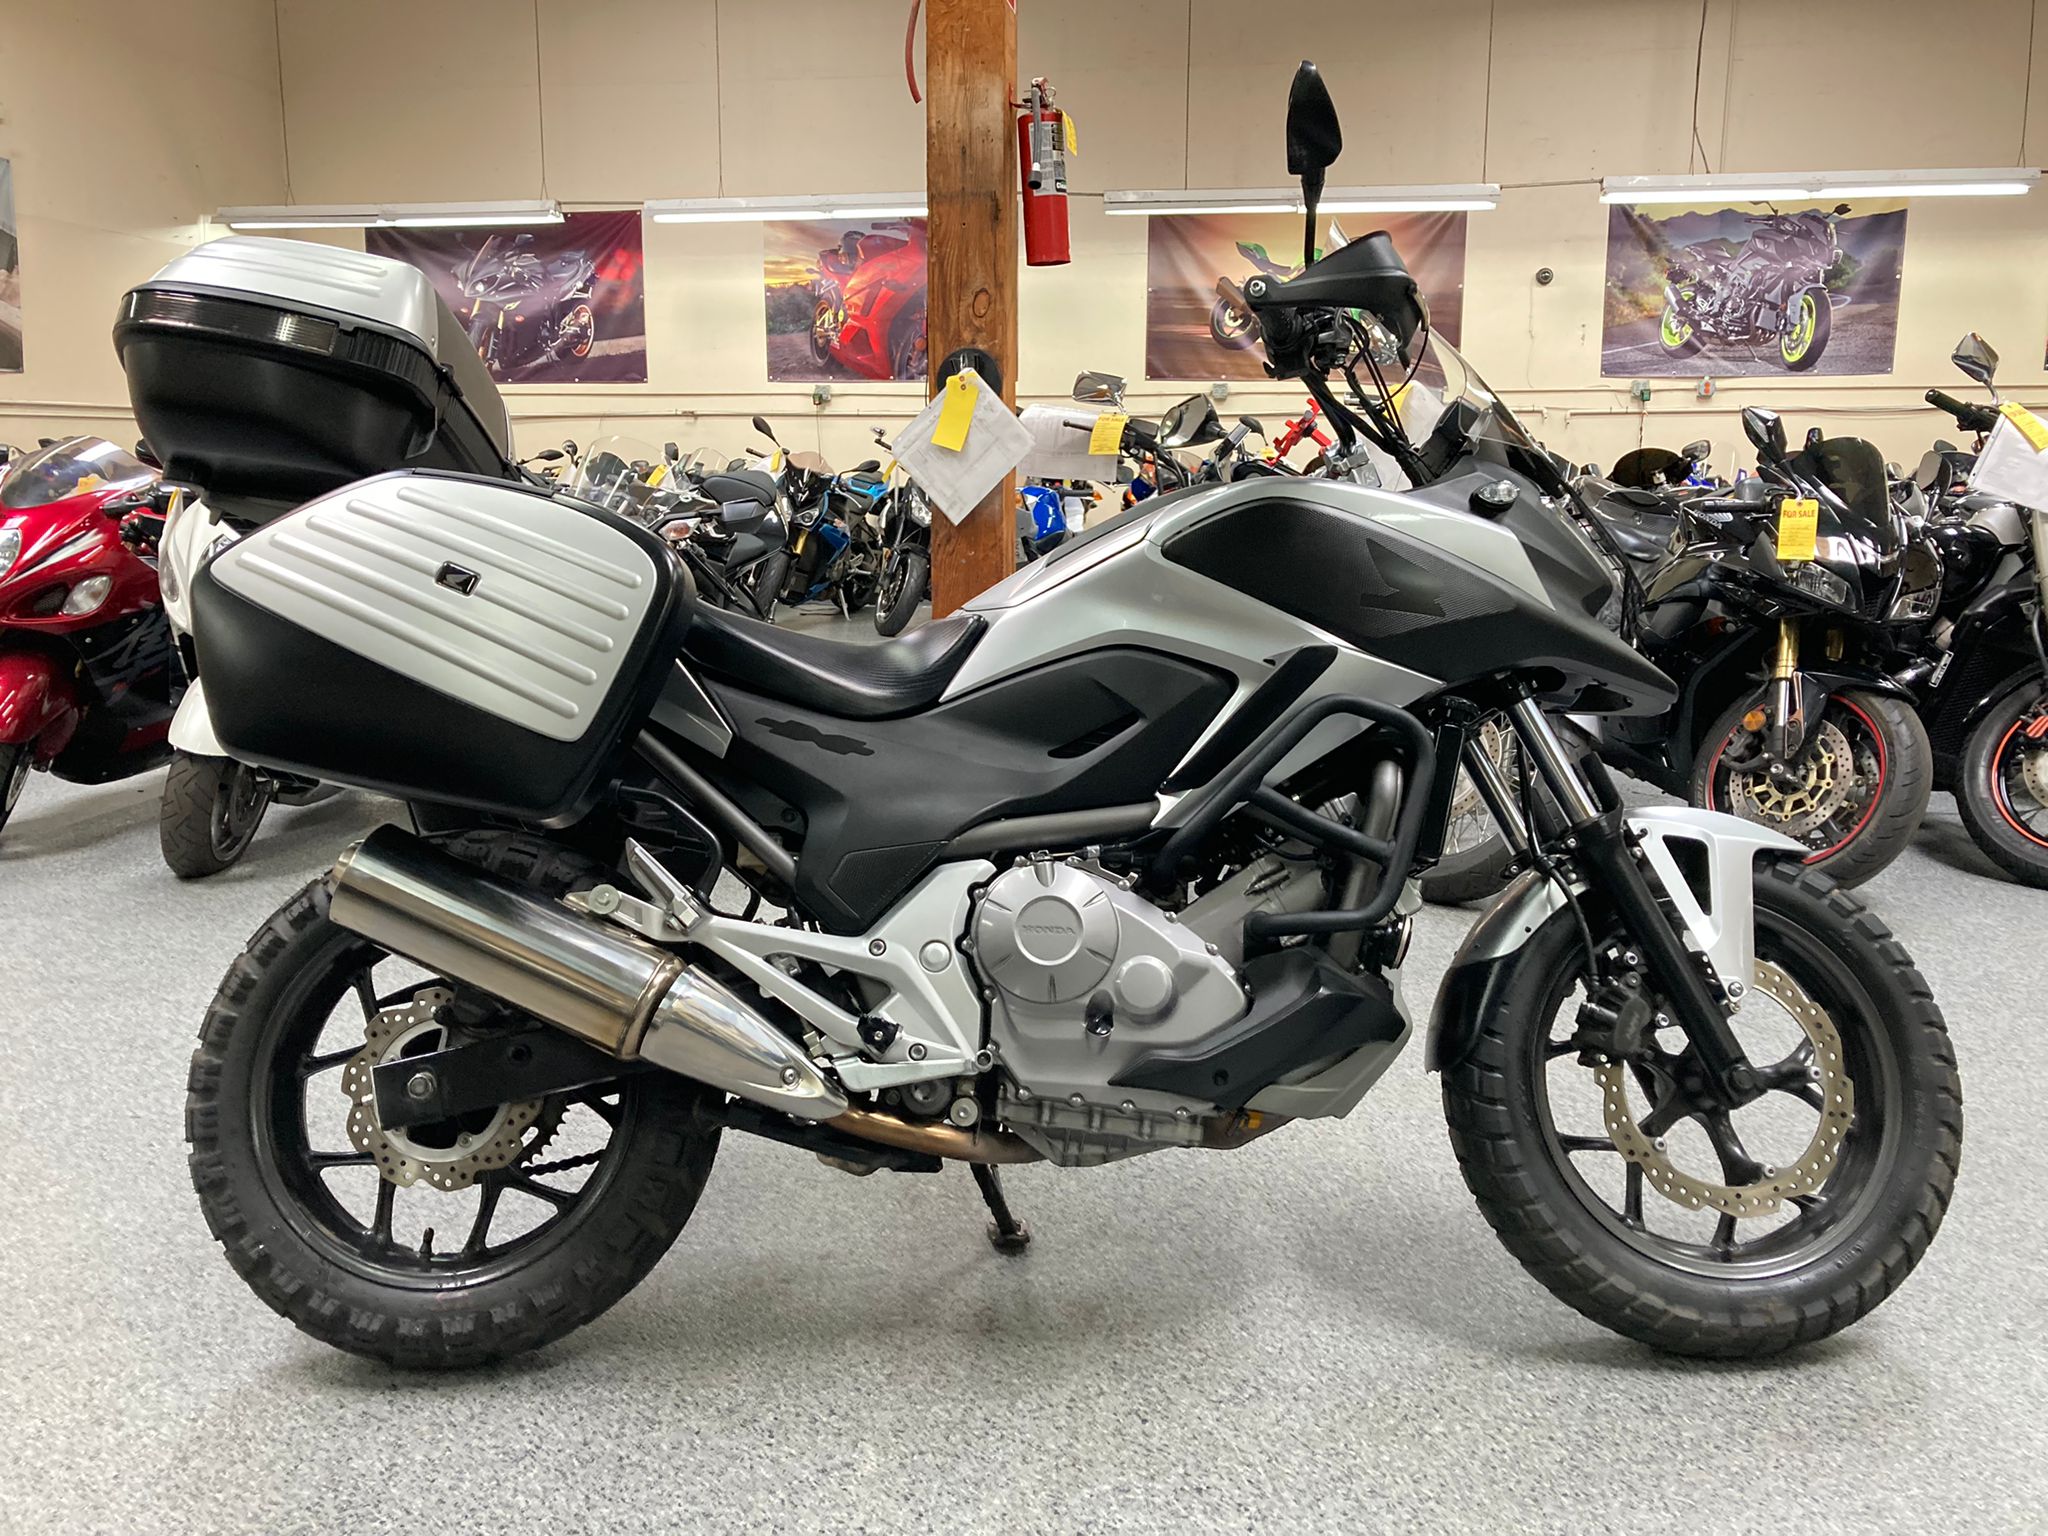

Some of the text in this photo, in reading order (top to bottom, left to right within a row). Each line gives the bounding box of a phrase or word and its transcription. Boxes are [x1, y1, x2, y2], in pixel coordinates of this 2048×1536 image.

[1783, 509, 1815, 518] FOR SALE
[1693, 509, 1723, 530] HONDA
[1022, 924, 1076, 935] HONDA
